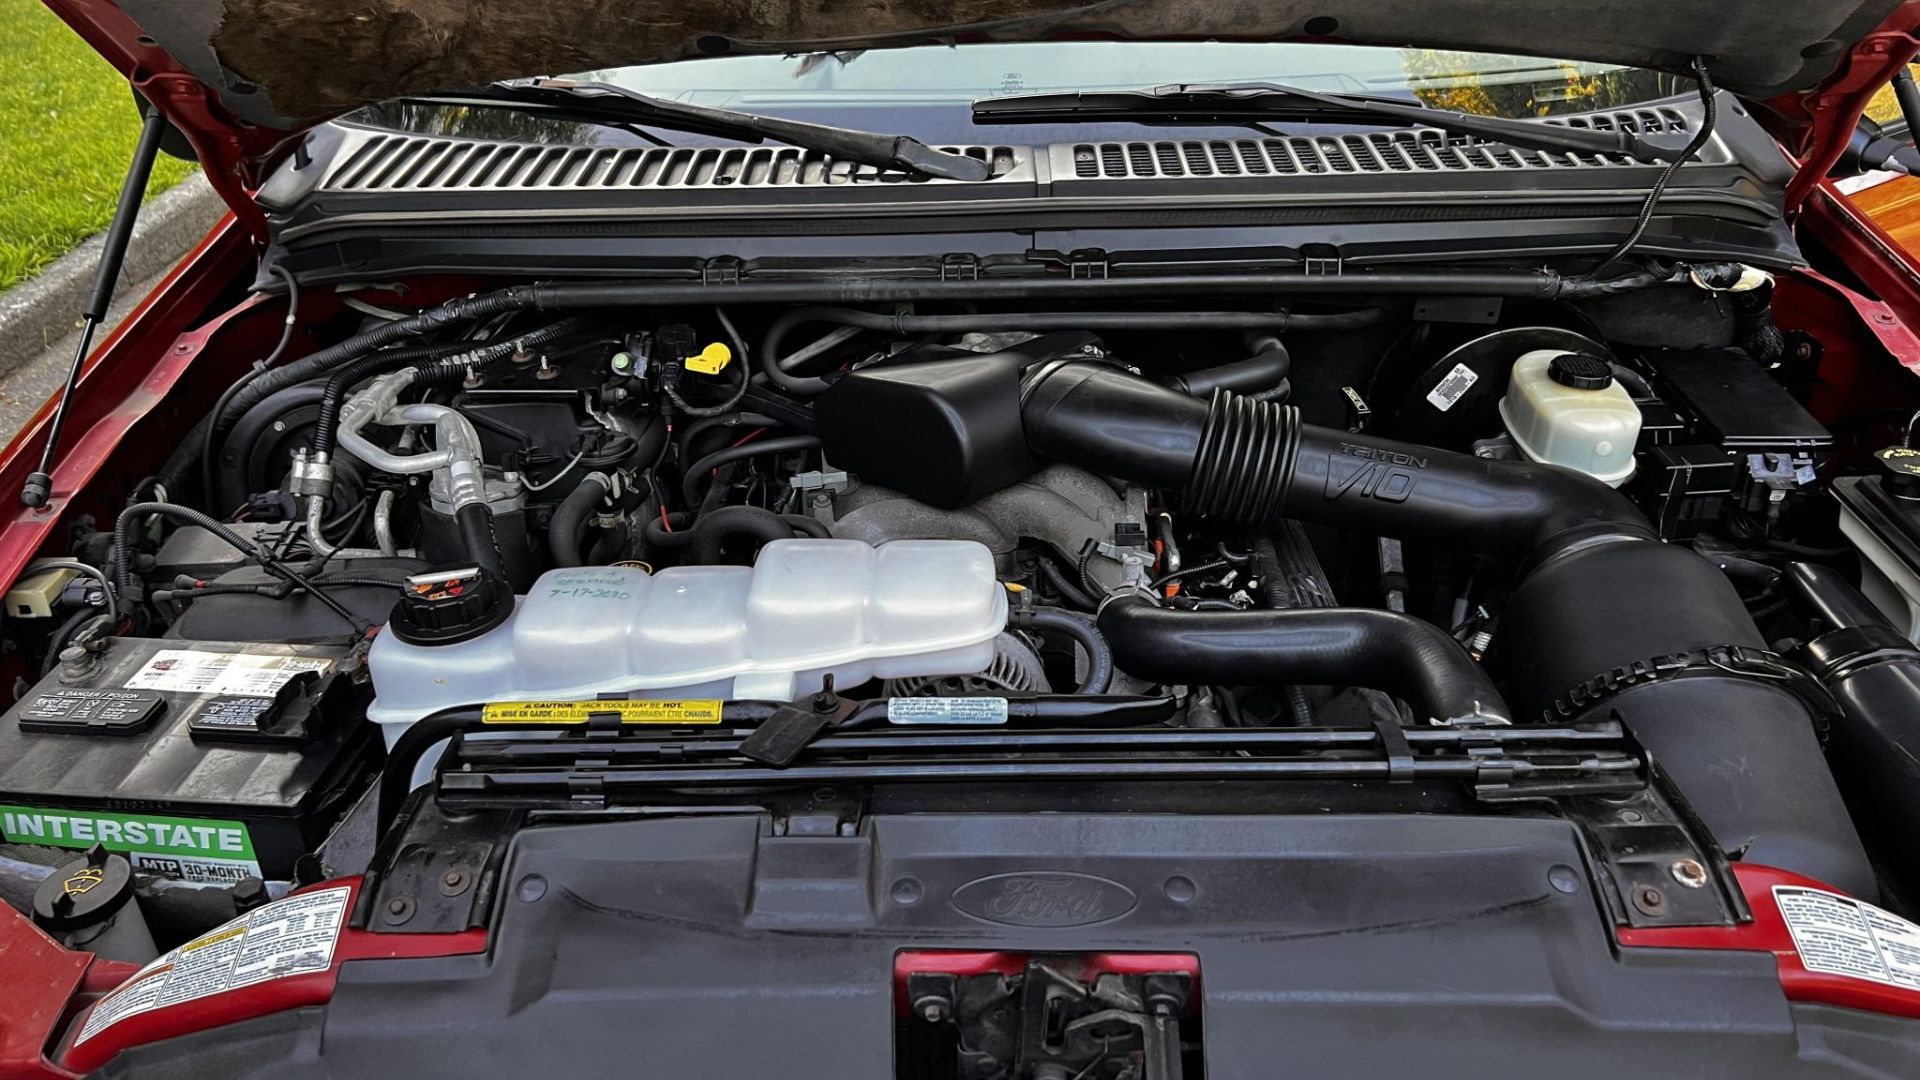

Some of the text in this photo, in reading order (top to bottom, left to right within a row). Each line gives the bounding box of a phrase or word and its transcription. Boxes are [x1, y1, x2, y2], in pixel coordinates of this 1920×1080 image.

[1340, 442, 1428, 469] TRITON
[1324, 454, 1419, 504] V10
[501, 710, 517, 718] MISE
[519, 710, 528, 718] EN
[3, 812, 244, 852] INTERSTATE
[141, 859, 178, 872] MTP
[184, 864, 251, 880] 30-MONTH
[985, 877, 1101, 919] Ford
